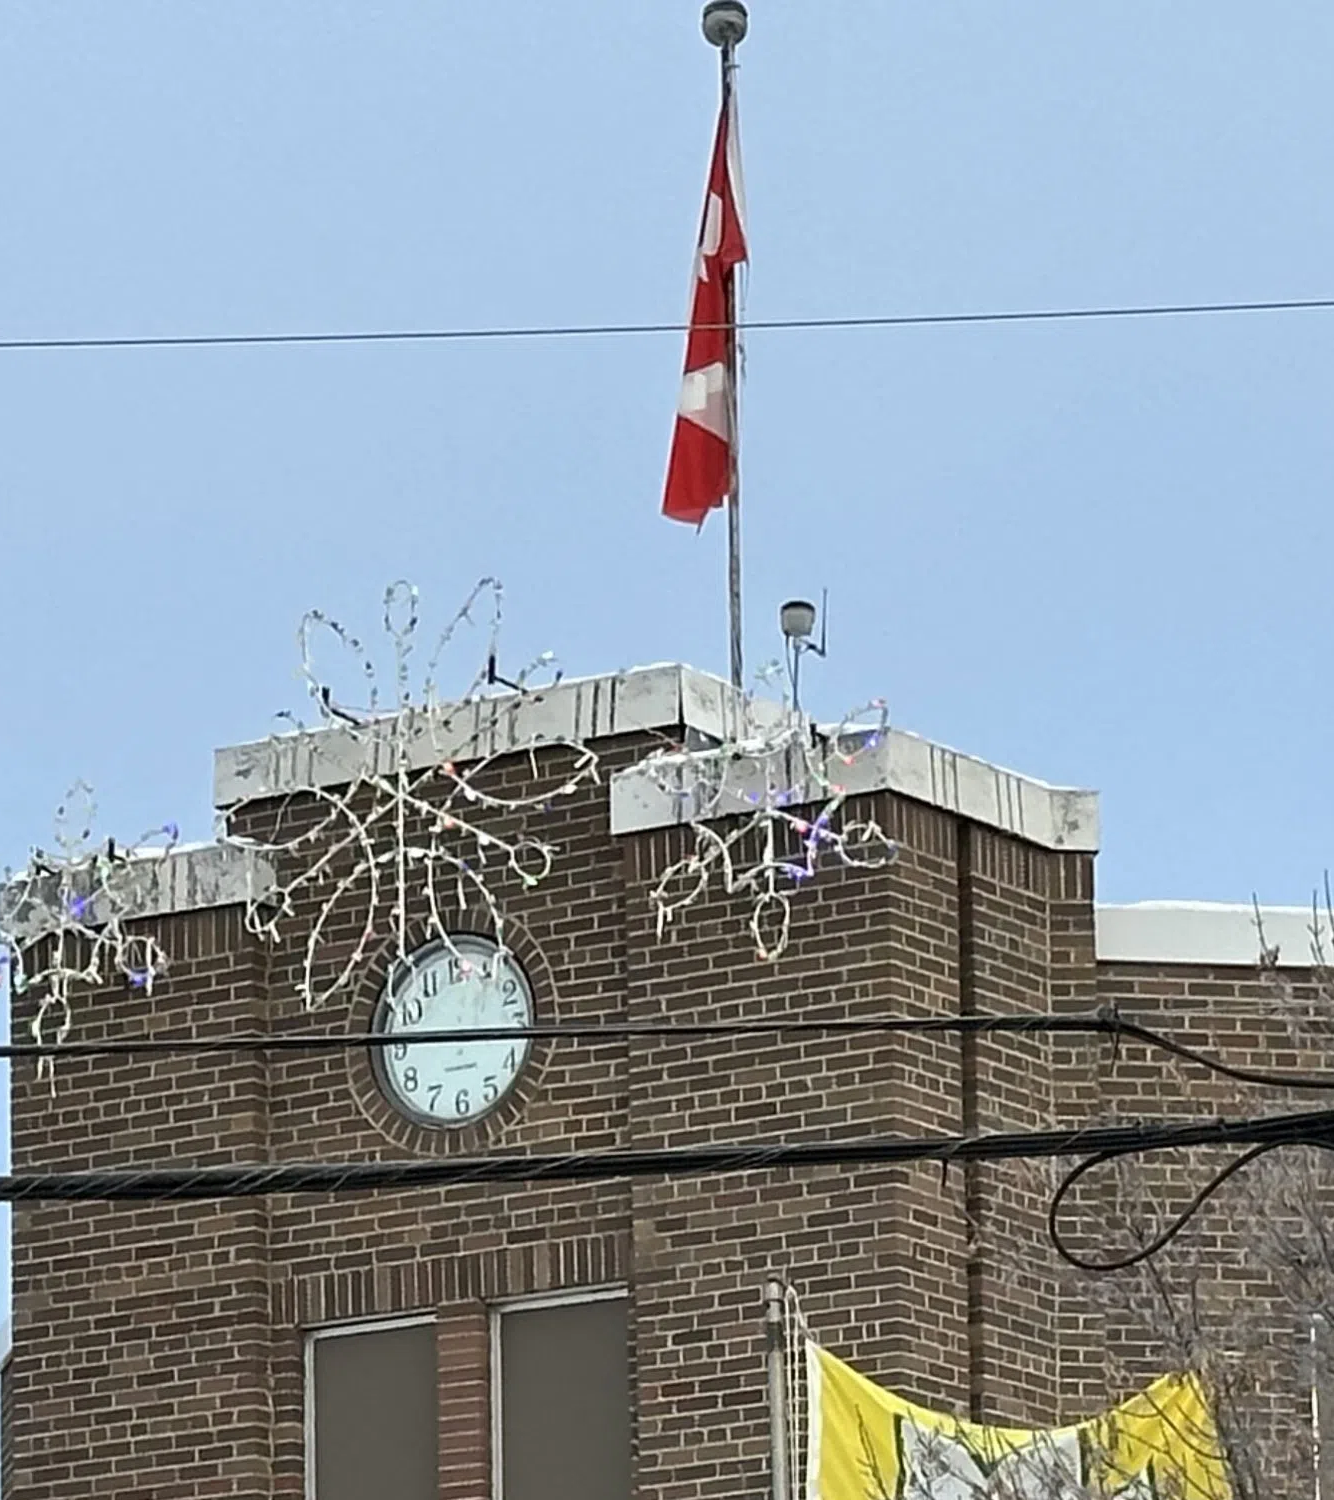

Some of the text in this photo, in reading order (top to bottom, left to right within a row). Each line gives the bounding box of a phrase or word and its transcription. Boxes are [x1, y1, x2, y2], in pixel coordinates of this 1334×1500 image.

[423, 970, 437, 998] 11
[502, 978, 518, 1008] 2
[403, 998, 423, 1026] 10
[503, 1045, 517, 1074] 4
[404, 1066, 418, 1092] 8
[483, 1075, 498, 1103] 5
[427, 1084, 443, 1112] 7
[455, 1089, 470, 1115] 6
